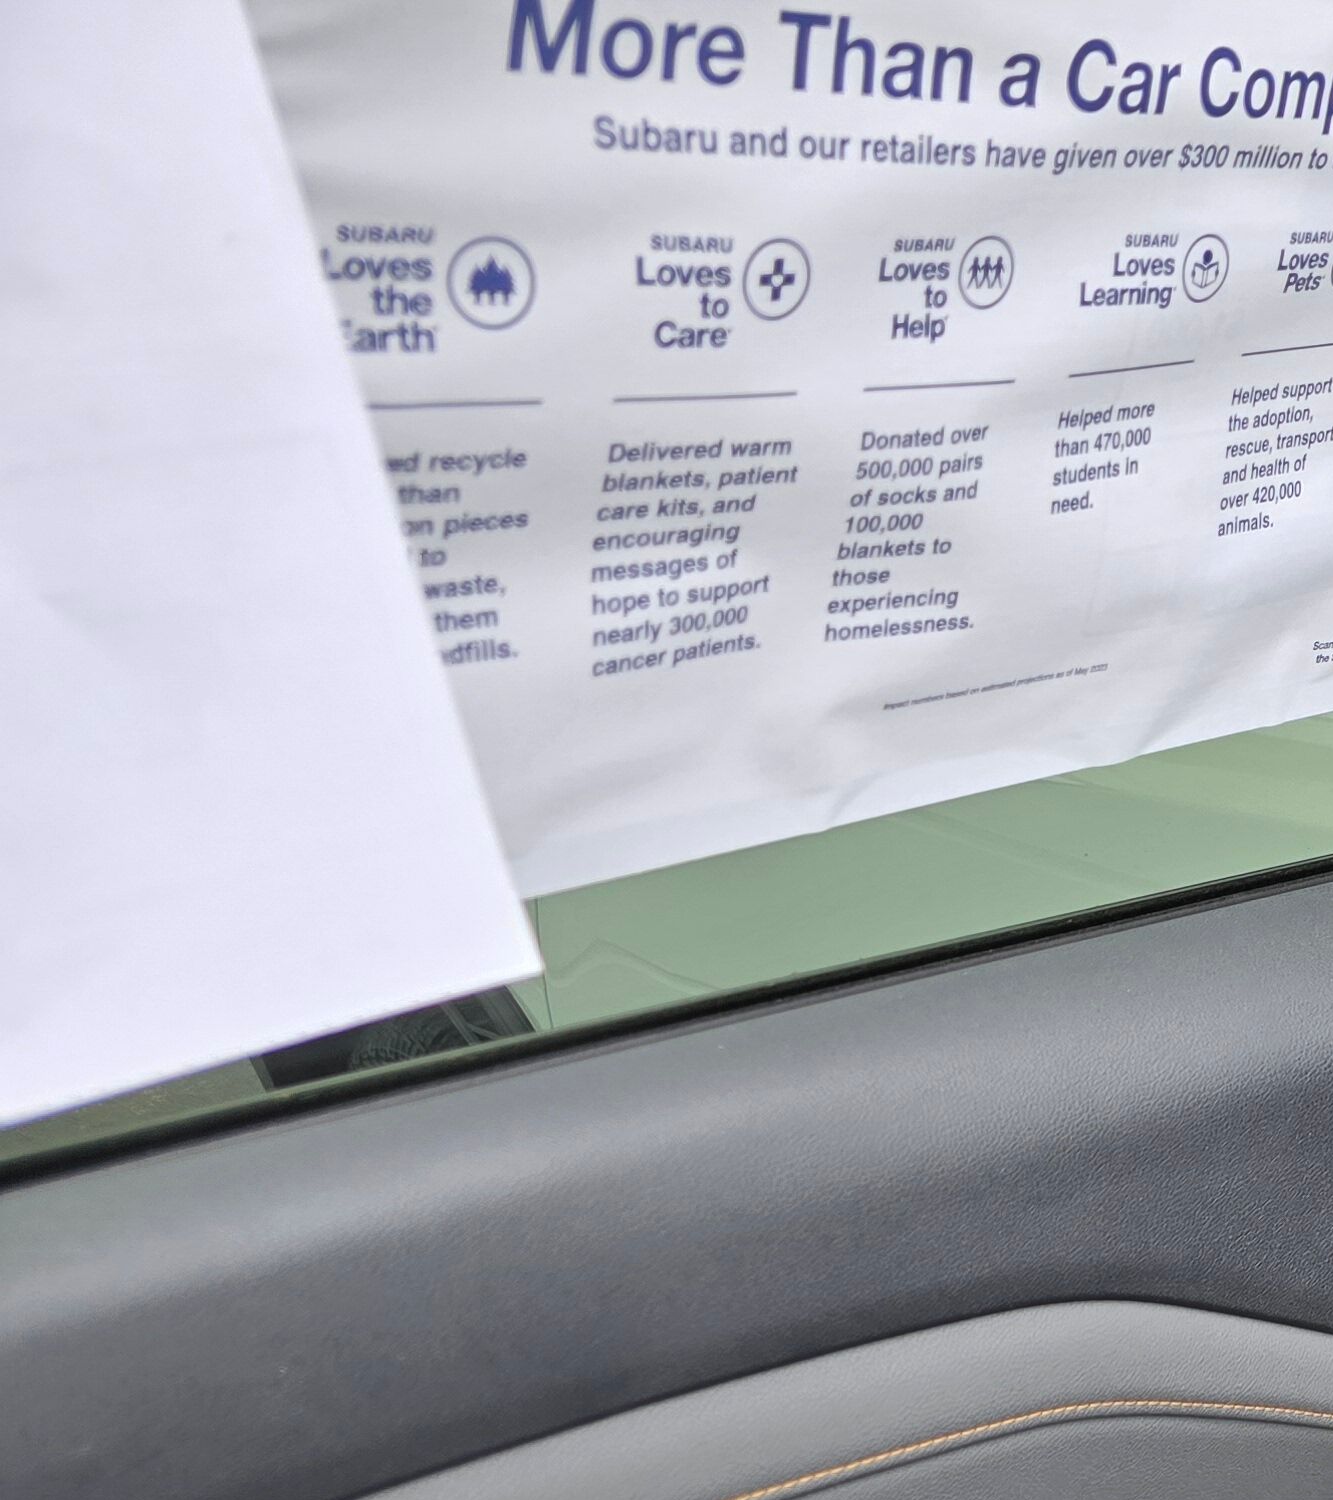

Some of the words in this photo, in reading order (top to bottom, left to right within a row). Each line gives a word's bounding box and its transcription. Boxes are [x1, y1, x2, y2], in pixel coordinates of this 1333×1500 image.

[508, 0, 745, 86] More
[779, 11, 975, 103] Than
[998, 50, 1042, 109] a
[1067, 38, 1182, 115] Car
[593, 114, 719, 155] Subaru
[729, 126, 788, 158] and
[799, 135, 850, 161] our
[860, 136, 976, 168] retailers
[986, 139, 1045, 170] have
[1052, 144, 1117, 176] given
[1124, 146, 1174, 170] over
[1178, 144, 1228, 171] $300
[1233, 145, 1304, 171] million
[1308, 148, 1328, 171] to
[335, 224, 435, 244] SUBARU
[650, 234, 735, 254] SUBARU
[893, 237, 956, 253] SUBARU
[1124, 233, 1179, 250] SUBARU
[321, 248, 433, 281] Loves
[635, 258, 732, 289] Loves
[878, 258, 951, 284] Loves
[1113, 253, 1175, 278] Loves
[1277, 248, 1329, 271] Loves
[1079, 282, 1173, 310] Learning
[1283, 272, 1321, 293] Pets
[372, 283, 433, 316] the
[698, 294, 730, 319] to
[923, 286, 948, 309] to
[654, 321, 727, 349] Care
[890, 314, 947, 343] Help
[1231, 385, 1278, 409] Helped
[1281, 377, 1333, 403] support
[1057, 406, 1113, 432] Helped
[1117, 401, 1156, 421] more
[1228, 414, 1249, 433] the
[1252, 405, 1315, 432] adoption,
[608, 438, 722, 465] Delivered
[729, 436, 793, 459] warm
[860, 427, 945, 454] Donated
[949, 424, 989, 446] over
[1054, 435, 1090, 458] than
[1094, 426, 1153, 453] 470,000
[1225, 434, 1273, 460] rescue,
[429, 448, 528, 476] recycle
[855, 456, 934, 483] 500,000
[939, 453, 984, 480] pairs
[1053, 462, 1121, 487] students
[1124, 458, 1140, 477] in
[1223, 465, 1248, 486] and
[1252, 459, 1289, 481] health
[1293, 454, 1309, 474] of
[601, 465, 712, 495] blankets,
[717, 463, 799, 492] patient
[596, 501, 649, 522] care
[657, 497, 706, 521] kits,
[712, 493, 756, 516] and
[850, 487, 873, 508] of
[877, 484, 938, 507] socks
[942, 480, 980, 502] and
[1050, 492, 1095, 516] need.
[1219, 492, 1250, 511] over
[1253, 481, 1302, 507] 420,000
[443, 512, 529, 540] pieces
[592, 522, 741, 554] encouraging
[844, 512, 924, 536] 100,000
[1217, 514, 1275, 538] animals.
[837, 540, 926, 562] blankets
[932, 536, 953, 556] to
[591, 553, 710, 586] messages
[716, 549, 739, 572] of
[831, 566, 891, 587] those
[423, 575, 507, 600] waste,
[591, 592, 651, 619] hope
[658, 584, 679, 609] to
[686, 574, 772, 607] support
[826, 587, 959, 617] experiencing
[434, 609, 500, 633] them
[592, 619, 662, 649] nearly
[669, 604, 749, 638] 300,000
[823, 611, 976, 644] homelessness.
[591, 647, 667, 679] cancer
[672, 631, 761, 665] patients.
[1313, 641, 1333, 650] Scan
[1316, 654, 1330, 663] the
